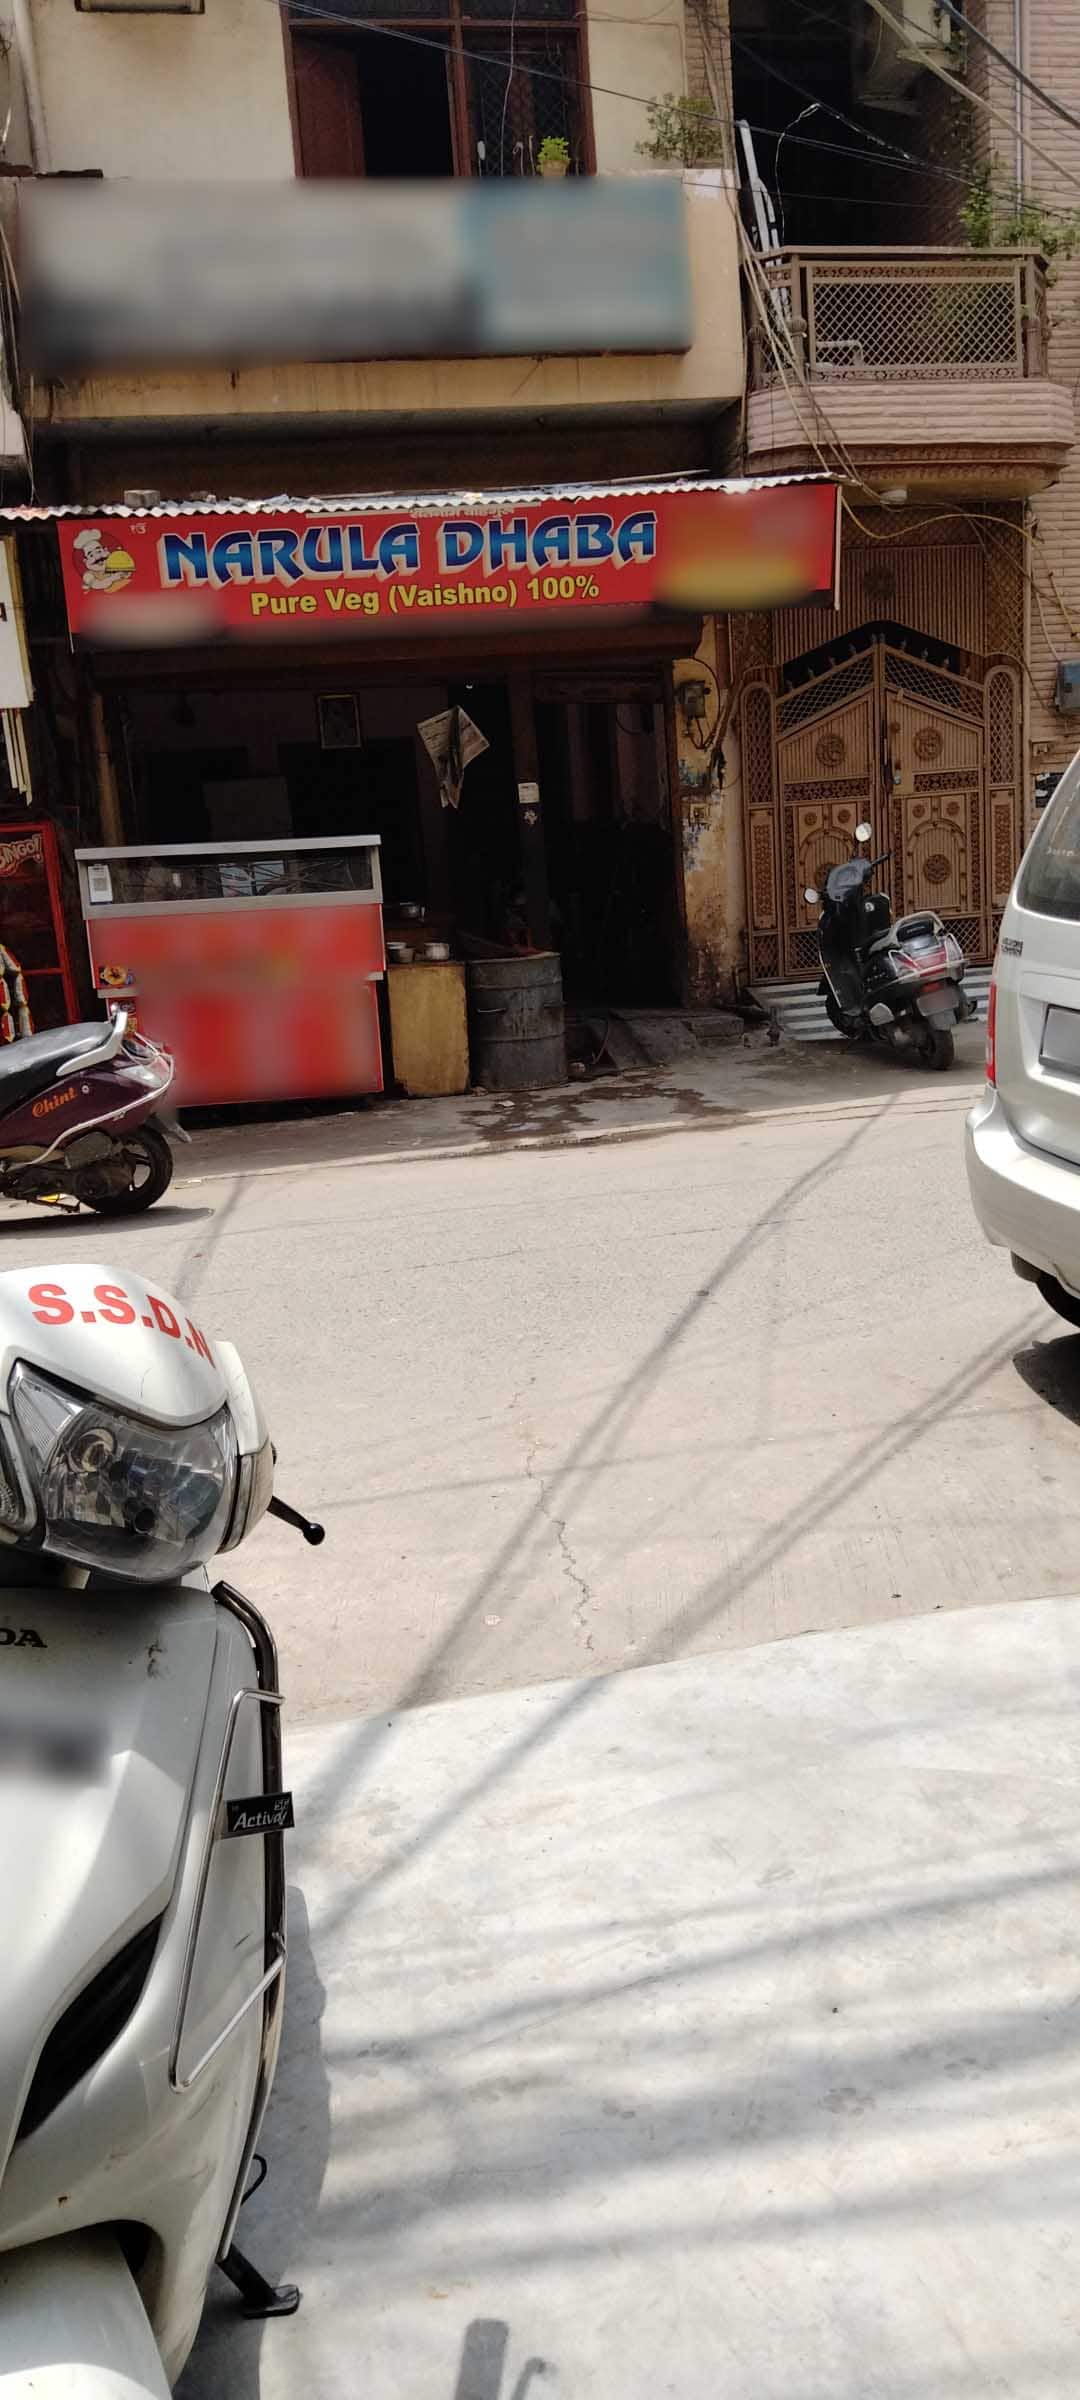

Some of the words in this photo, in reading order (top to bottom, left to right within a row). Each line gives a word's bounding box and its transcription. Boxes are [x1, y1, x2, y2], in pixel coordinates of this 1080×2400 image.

[158, 522, 419, 590] NARULA
[437, 511, 658, 578] DHABA
[251, 591, 317, 616] Pure
[325, 587, 380, 615] Veg
[388, 579, 517, 613] (Vaishno)
[527, 574, 600, 600] 100%
